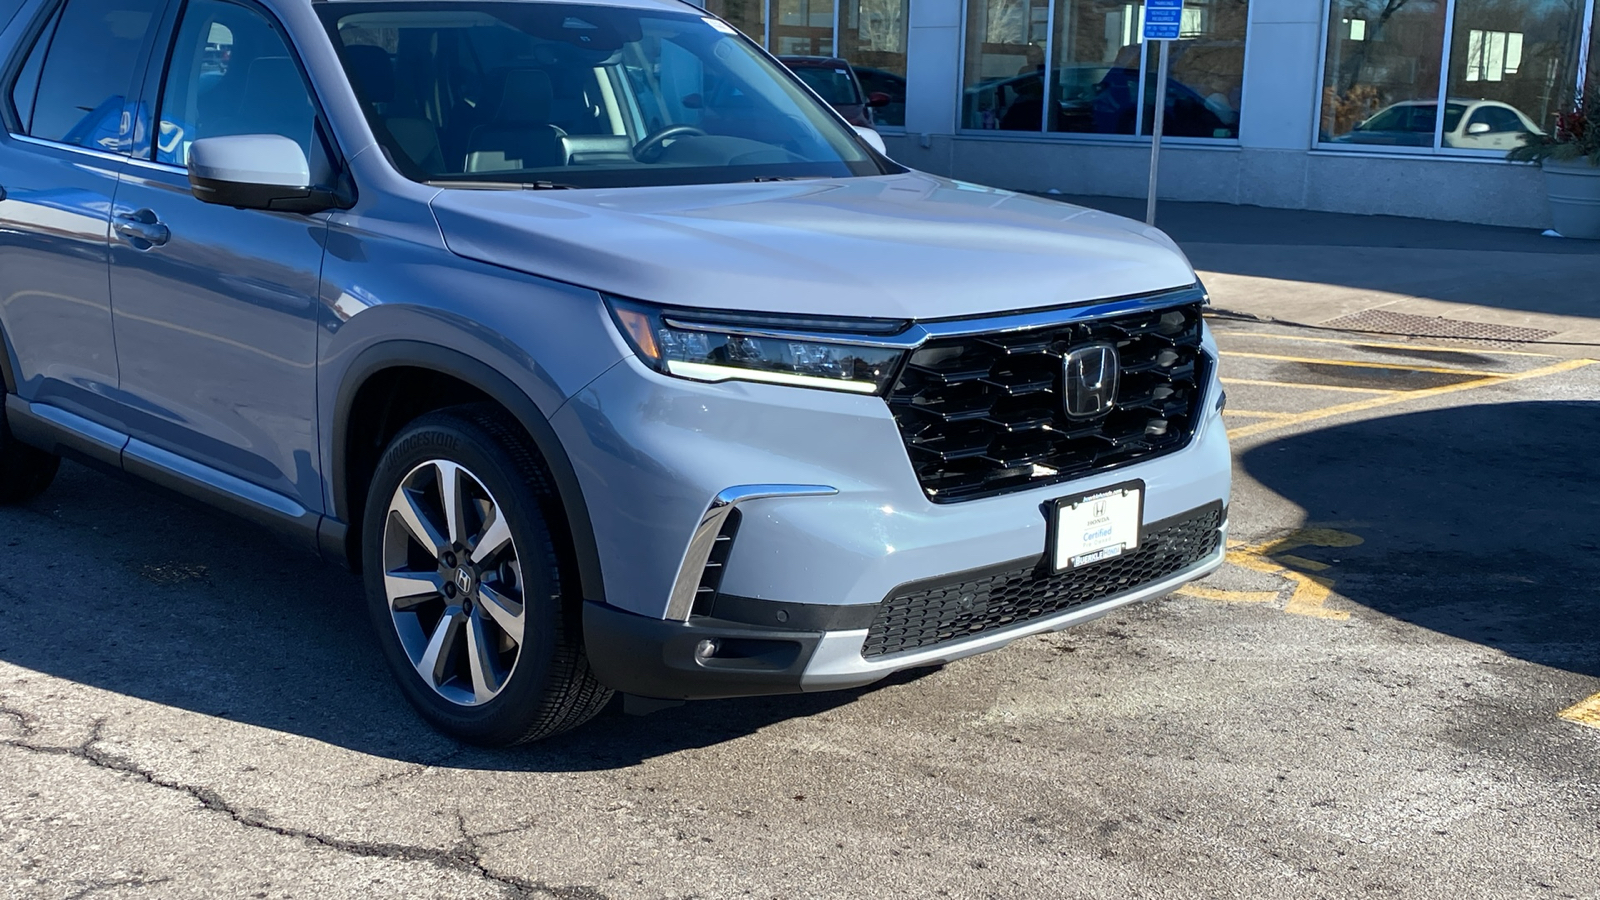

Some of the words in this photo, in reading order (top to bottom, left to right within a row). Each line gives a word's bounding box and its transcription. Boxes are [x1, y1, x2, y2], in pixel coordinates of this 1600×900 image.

[385, 430, 461, 471] BRIDGESTONE
[1087, 516, 1110, 526] HONDA
[1083, 525, 1112, 542] Certified
